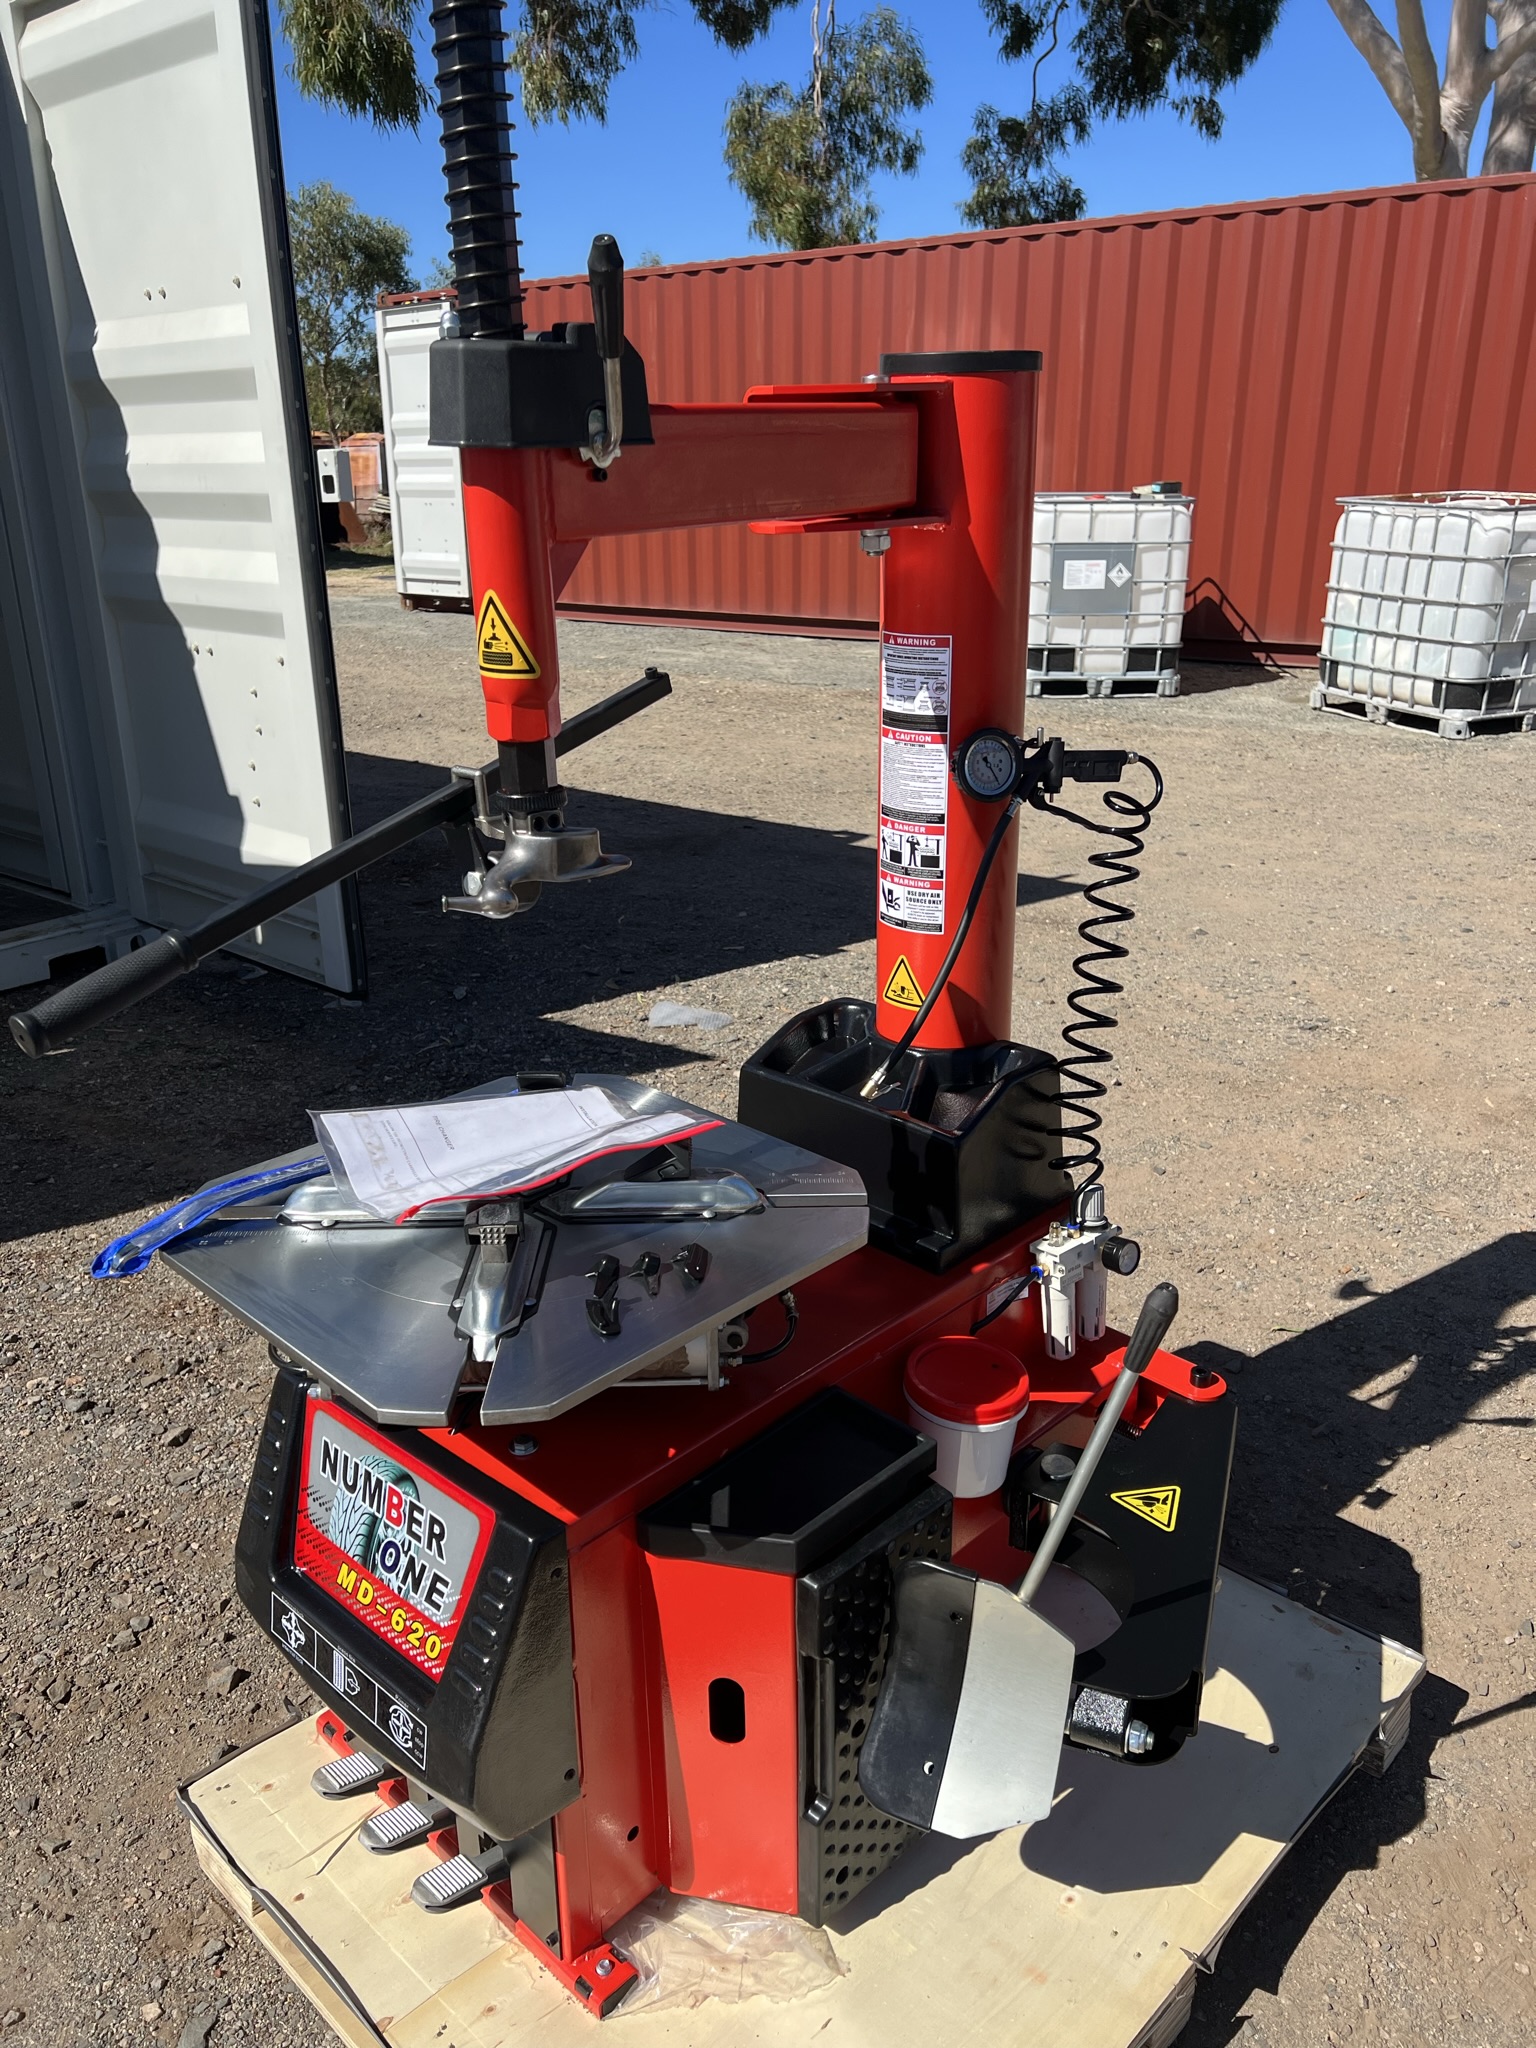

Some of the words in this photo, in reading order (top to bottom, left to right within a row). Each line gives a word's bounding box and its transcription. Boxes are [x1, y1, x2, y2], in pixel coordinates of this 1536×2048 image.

[897, 636, 936, 646] WARNING
[895, 732, 932, 742] CAUTION
[894, 822, 926, 833] DANGER
[894, 876, 931, 888] WARNING
[906, 896, 927, 904] SOURCE
[438, 1126, 455, 1150] CHANGER
[320, 1436, 447, 1564] NUMBER
[379, 1537, 451, 1614] ONE
[336, 1561, 443, 1660] MD-620
